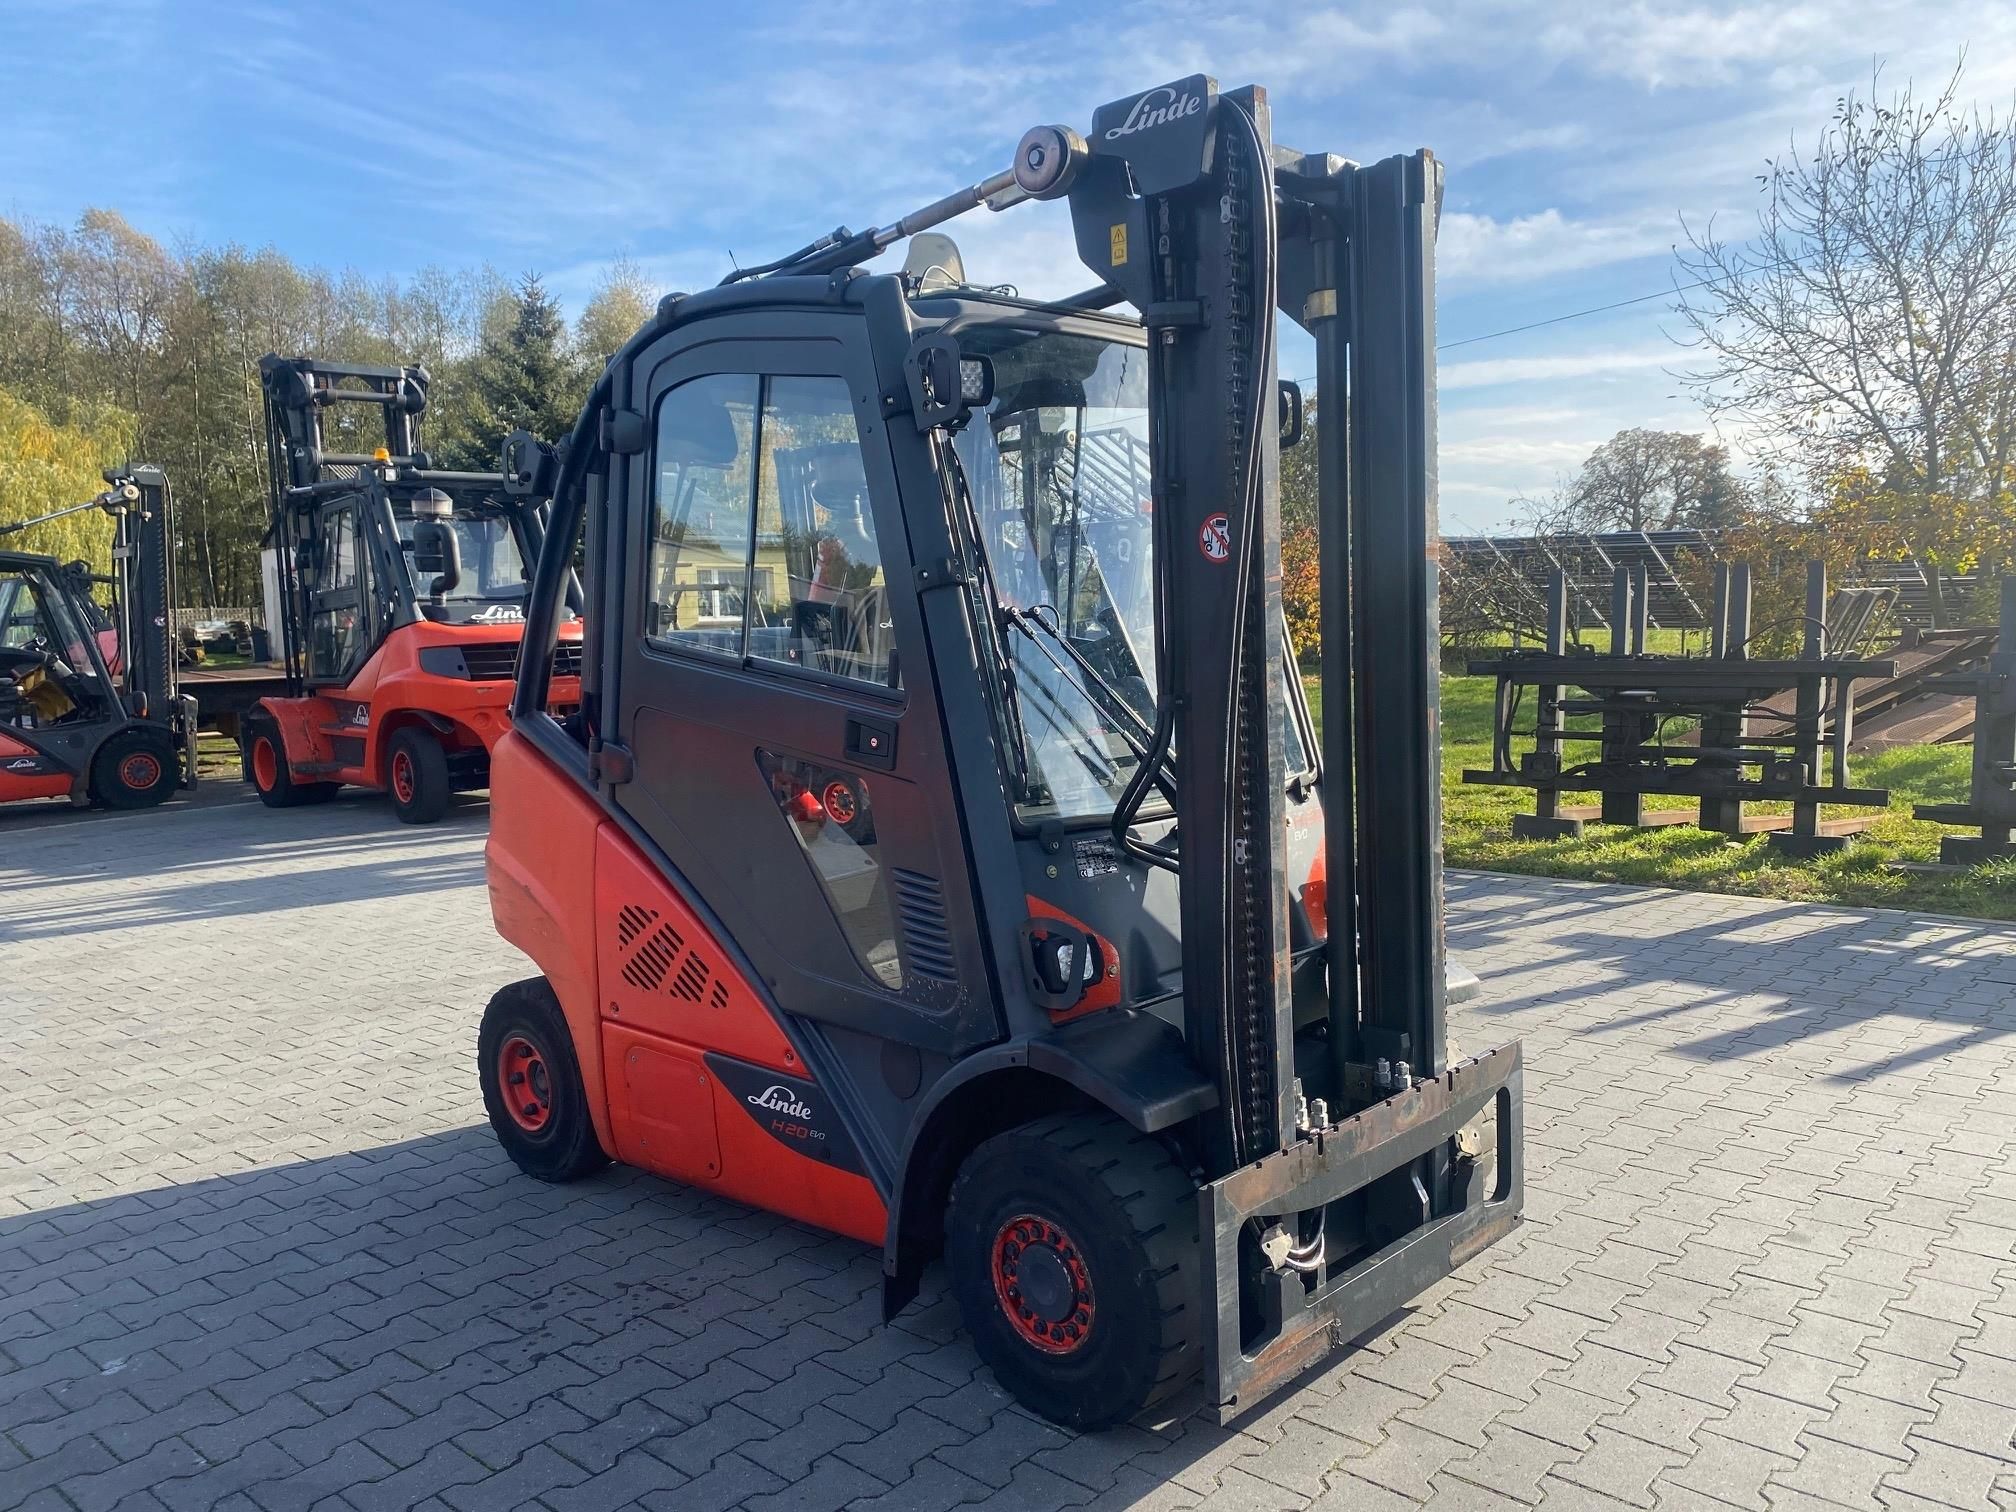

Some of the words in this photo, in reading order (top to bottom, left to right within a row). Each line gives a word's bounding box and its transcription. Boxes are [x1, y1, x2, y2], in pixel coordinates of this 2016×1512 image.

[1105, 88, 1200, 139] Linde
[747, 1085, 811, 1119] Linde
[771, 1119, 808, 1139] H20
[809, 1130, 826, 1140] EVO
